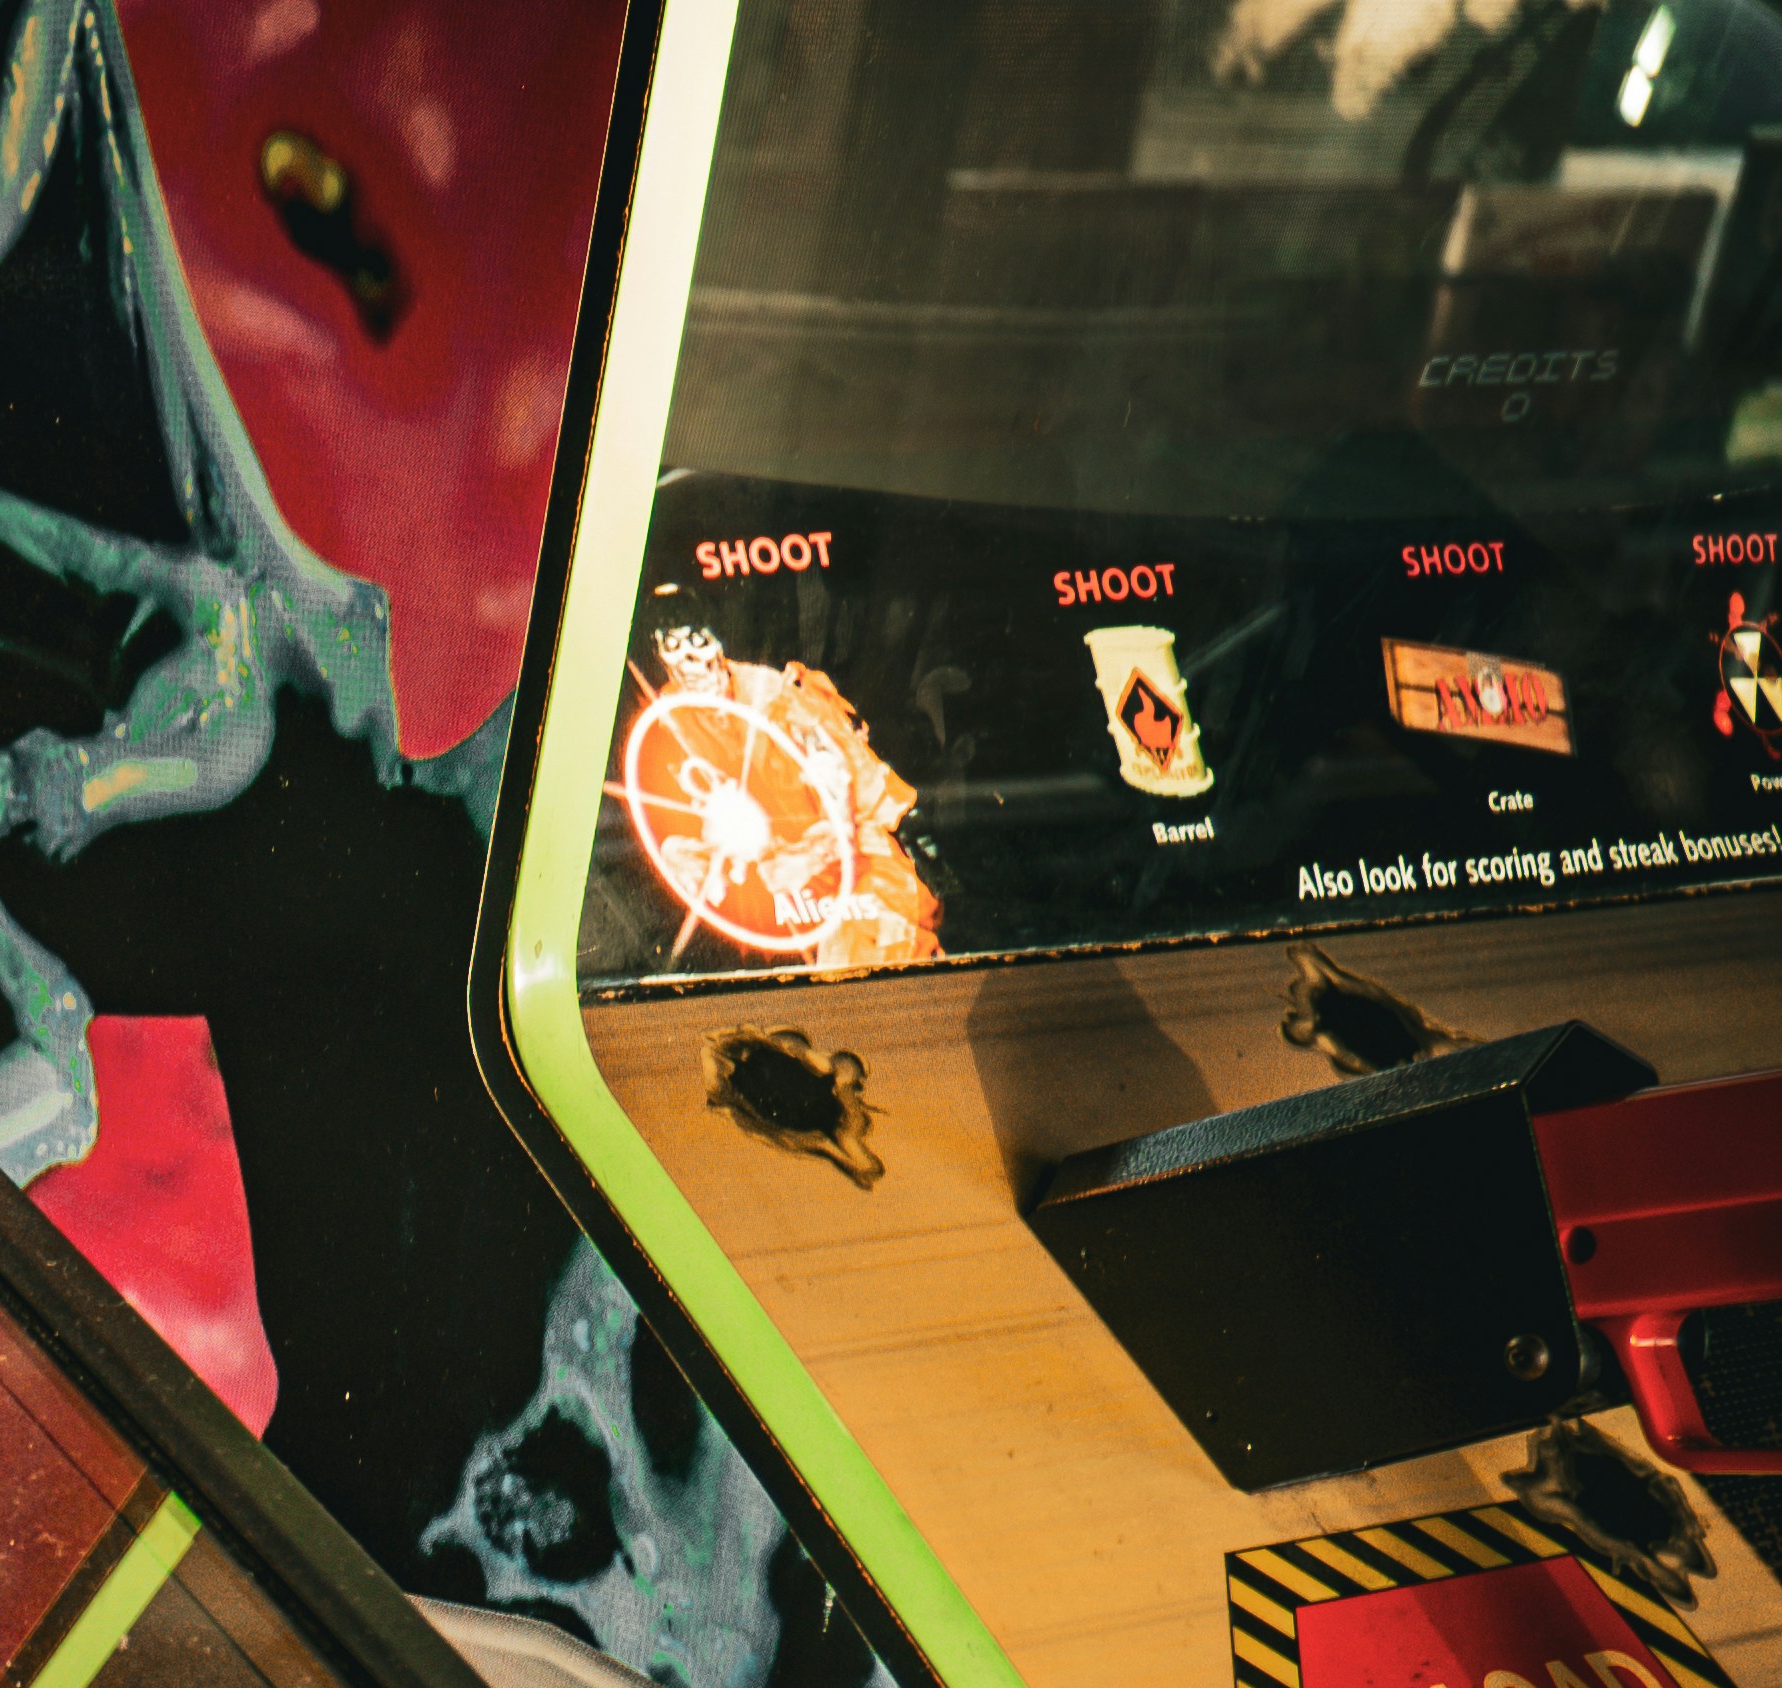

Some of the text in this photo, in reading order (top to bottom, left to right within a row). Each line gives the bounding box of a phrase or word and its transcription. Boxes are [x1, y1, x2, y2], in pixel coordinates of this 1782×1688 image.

[1419, 351, 1619, 388] CREDITS
[695, 531, 833, 579] SHOOT
[1402, 541, 1506, 577] SHOOT
[1692, 533, 1778, 566] SHOOT
[1053, 563, 1175, 607] SHOOT
[1488, 789, 1534, 814] Crate
[1152, 815, 1215, 846] Barrel
[1298, 824, 1782, 900] Also look for scoring and streak bonuses!
[774, 889, 878, 928] Aliens
